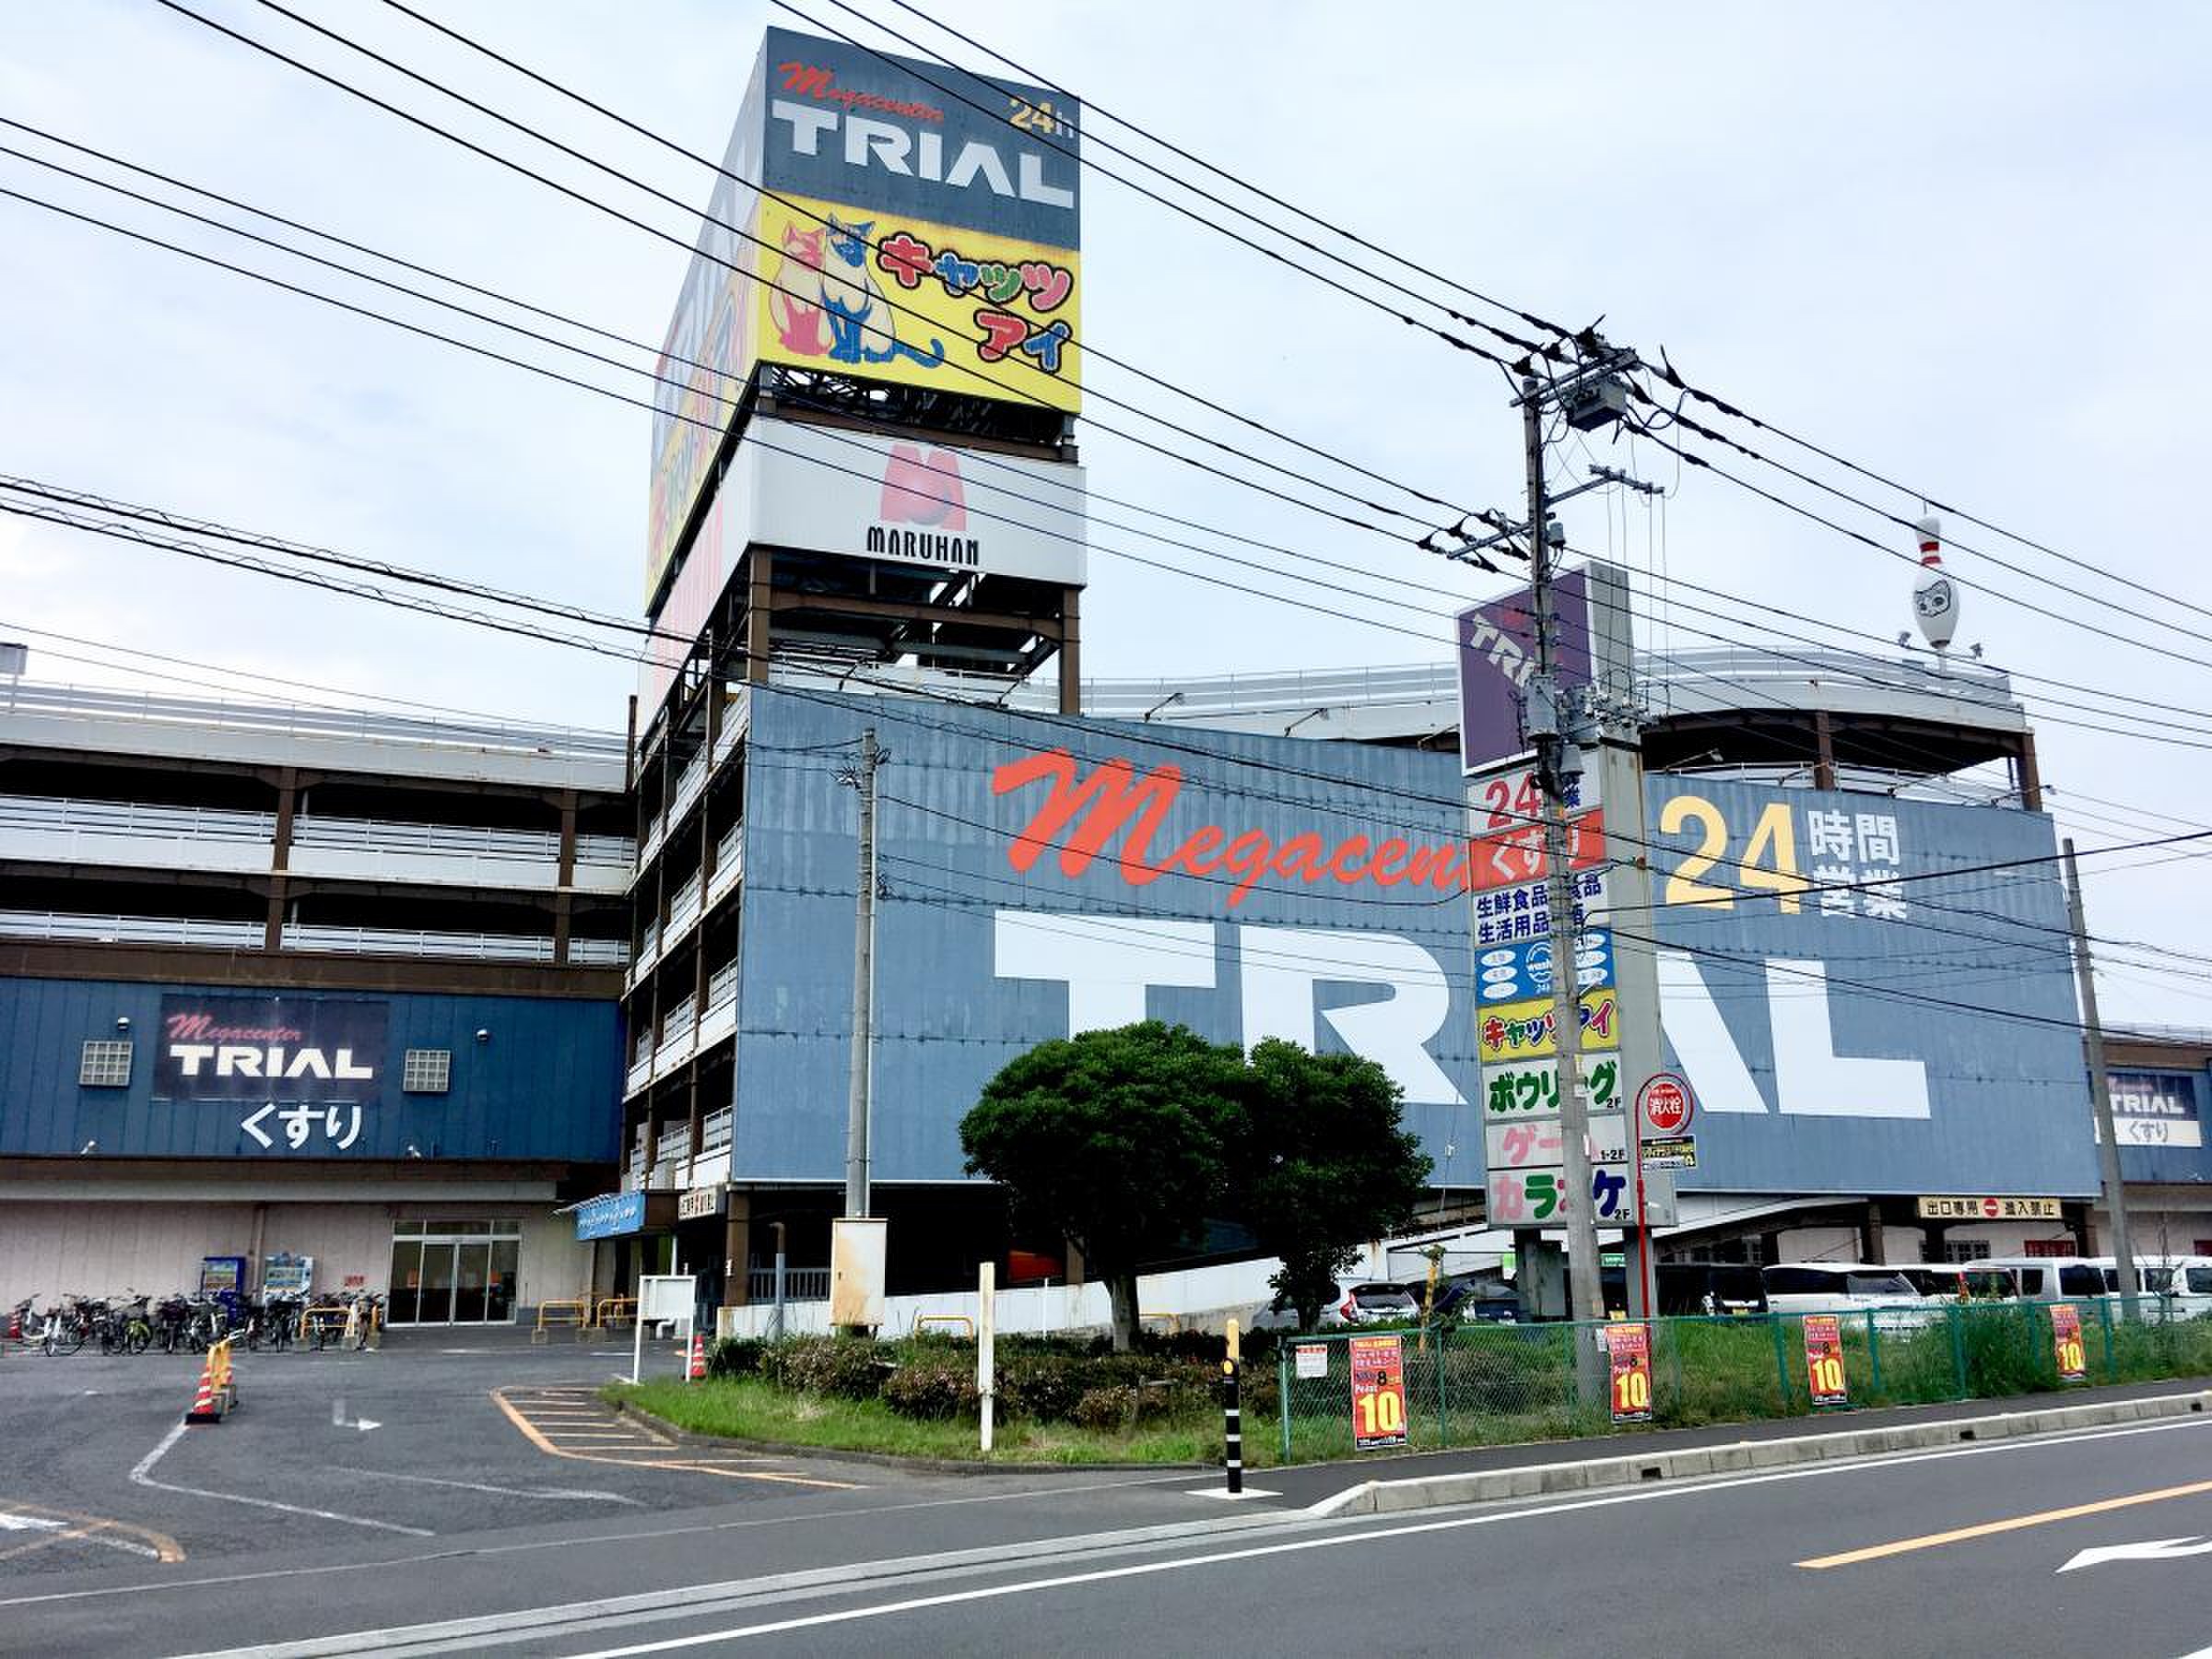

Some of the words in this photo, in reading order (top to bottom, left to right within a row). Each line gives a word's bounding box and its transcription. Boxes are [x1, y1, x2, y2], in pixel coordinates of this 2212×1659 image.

[771, 99, 1075, 209] TRIAL
[974, 309, 1073, 373] アイ
[867, 525, 980, 566] MARUHAN
[1486, 771, 1542, 830] 24
[992, 747, 1471, 909] Megacen
[1807, 809, 1900, 866] 時間
[1660, 795, 1809, 915] 24
[1477, 883, 1548, 919] 生鮮食品
[1813, 865, 1908, 920] 営業
[1477, 911, 1549, 945] 生活用品
[166, 1013, 305, 1042] Megacenter
[170, 1044, 373, 1079] TRIAL
[1606, 1097, 1622, 1109] 2F
[1650, 1096, 1682, 1116] 消火栓
[241, 1103, 362, 1151] くすり
[2129, 1121, 2169, 1143] くすり
[1614, 1208, 1630, 1220] 2F
[1926, 1201, 1979, 1217] 出口専用
[2058, 1342, 2081, 1371] 10
[1616, 1371, 1647, 1409] 10
[1812, 1358, 1843, 1393] 10
[1359, 1390, 1401, 1433] 10
